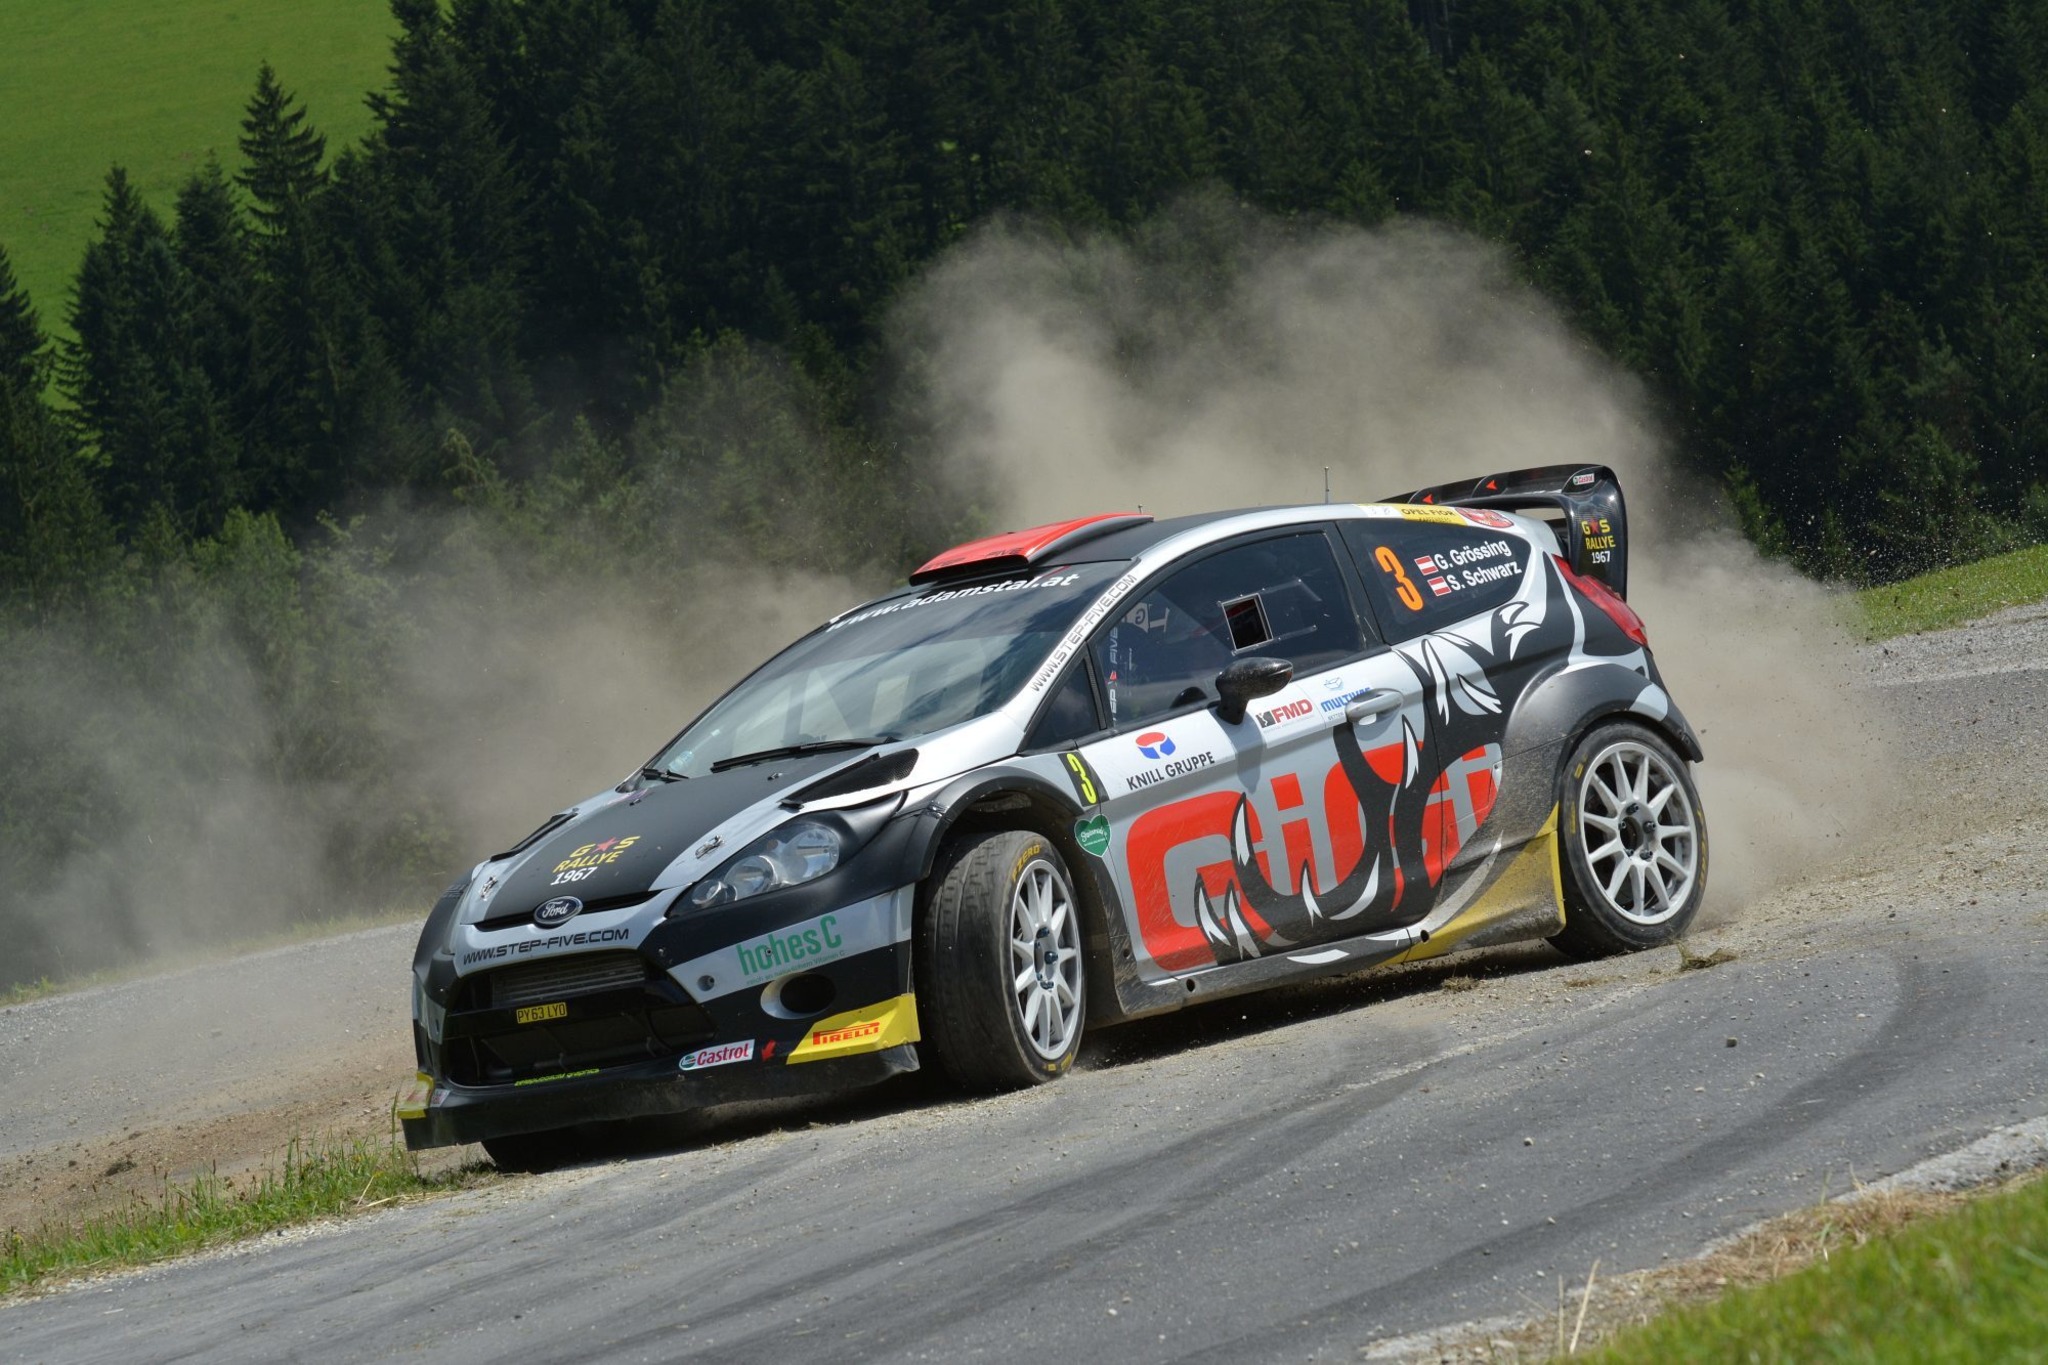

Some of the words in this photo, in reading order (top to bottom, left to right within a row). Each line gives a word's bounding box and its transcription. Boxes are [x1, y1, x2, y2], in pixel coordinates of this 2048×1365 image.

[1401, 508, 1428, 516] OPEL
[1585, 535, 1616, 550] RALLYE
[1433, 553, 1452, 571] G.
[1450, 540, 1512, 567] Grössing
[1591, 550, 1611, 564] 1967
[1374, 546, 1424, 611] 3
[1446, 575, 1466, 591] S.
[1462, 561, 1523, 587] Schwarz
[825, 572, 1081, 633] www.adamstal.at
[1031, 574, 1138, 692] WWW.STEP-FIVE.COM
[1270, 699, 1313, 724] FMD
[1066, 753, 1098, 804] 3
[1126, 768, 1165, 791] KNILL
[1165, 751, 1216, 778] GRUPPE
[552, 850, 624, 873] RALLYE
[549, 866, 598, 886] 1967
[541, 900, 568, 918] Ford
[463, 928, 629, 965] WWW.STEP-FIVE.COM
[517, 1007, 545, 1023] PY63
[812, 1022, 881, 1046] PIRELLI
[697, 1043, 750, 1066] Castrol
